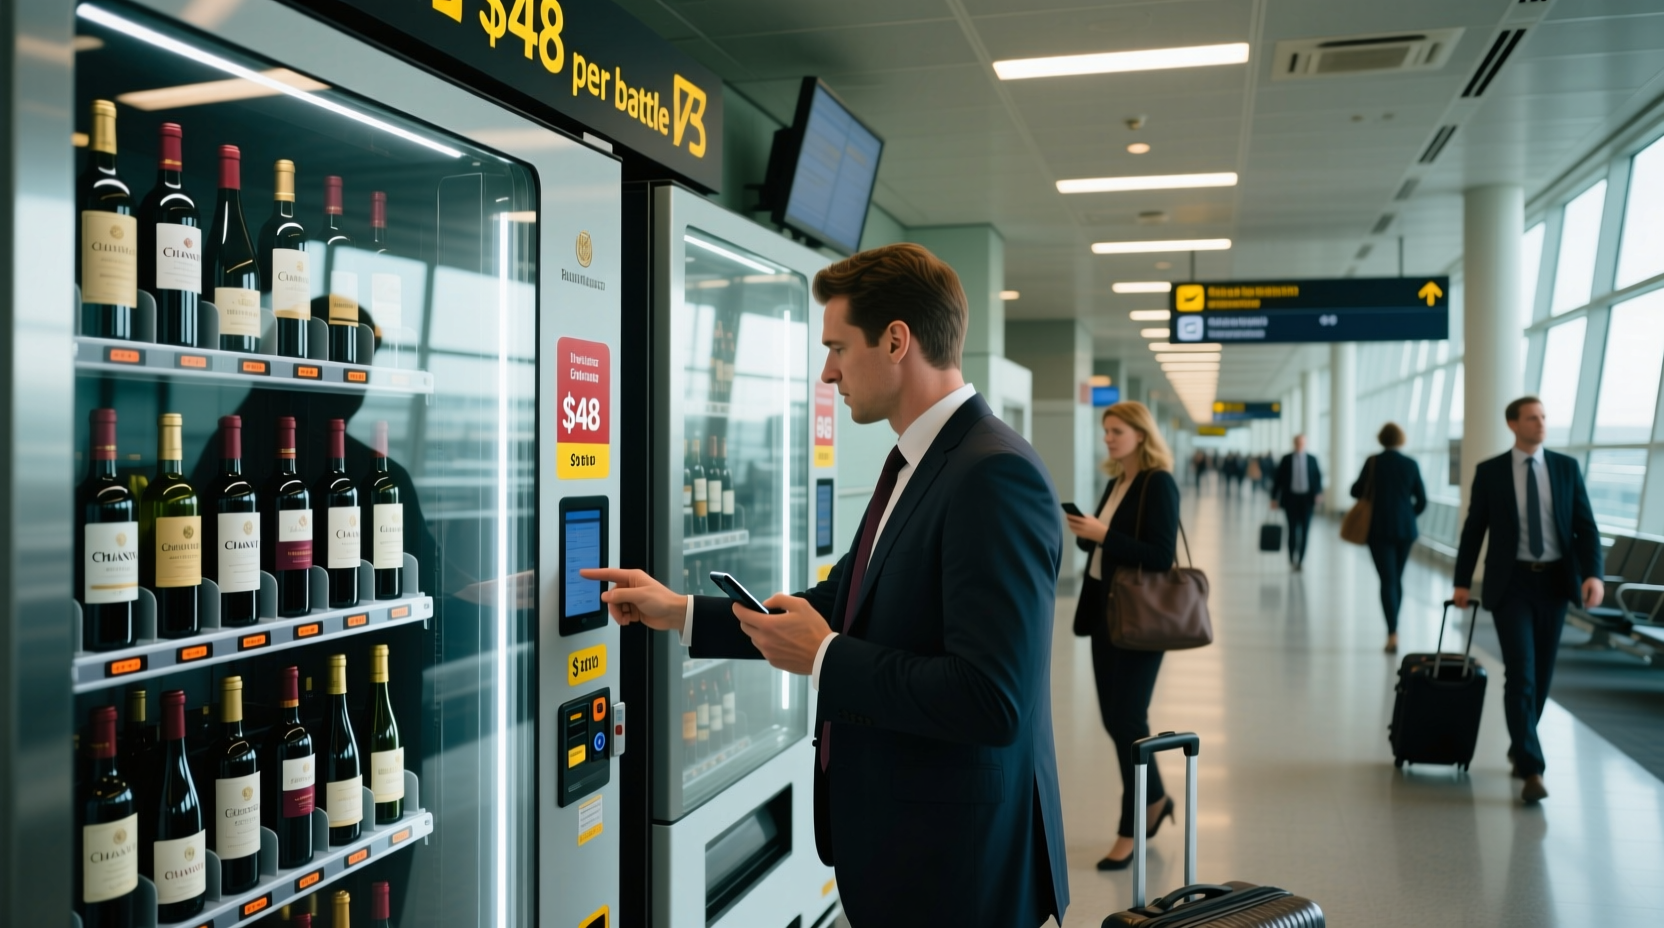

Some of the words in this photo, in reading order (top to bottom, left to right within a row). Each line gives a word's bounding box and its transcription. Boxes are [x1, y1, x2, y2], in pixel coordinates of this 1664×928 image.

[479, 0, 565, 74] $48
[572, 51, 611, 97] per
[614, 66, 670, 136] battle
[562, 391, 600, 434] $48
